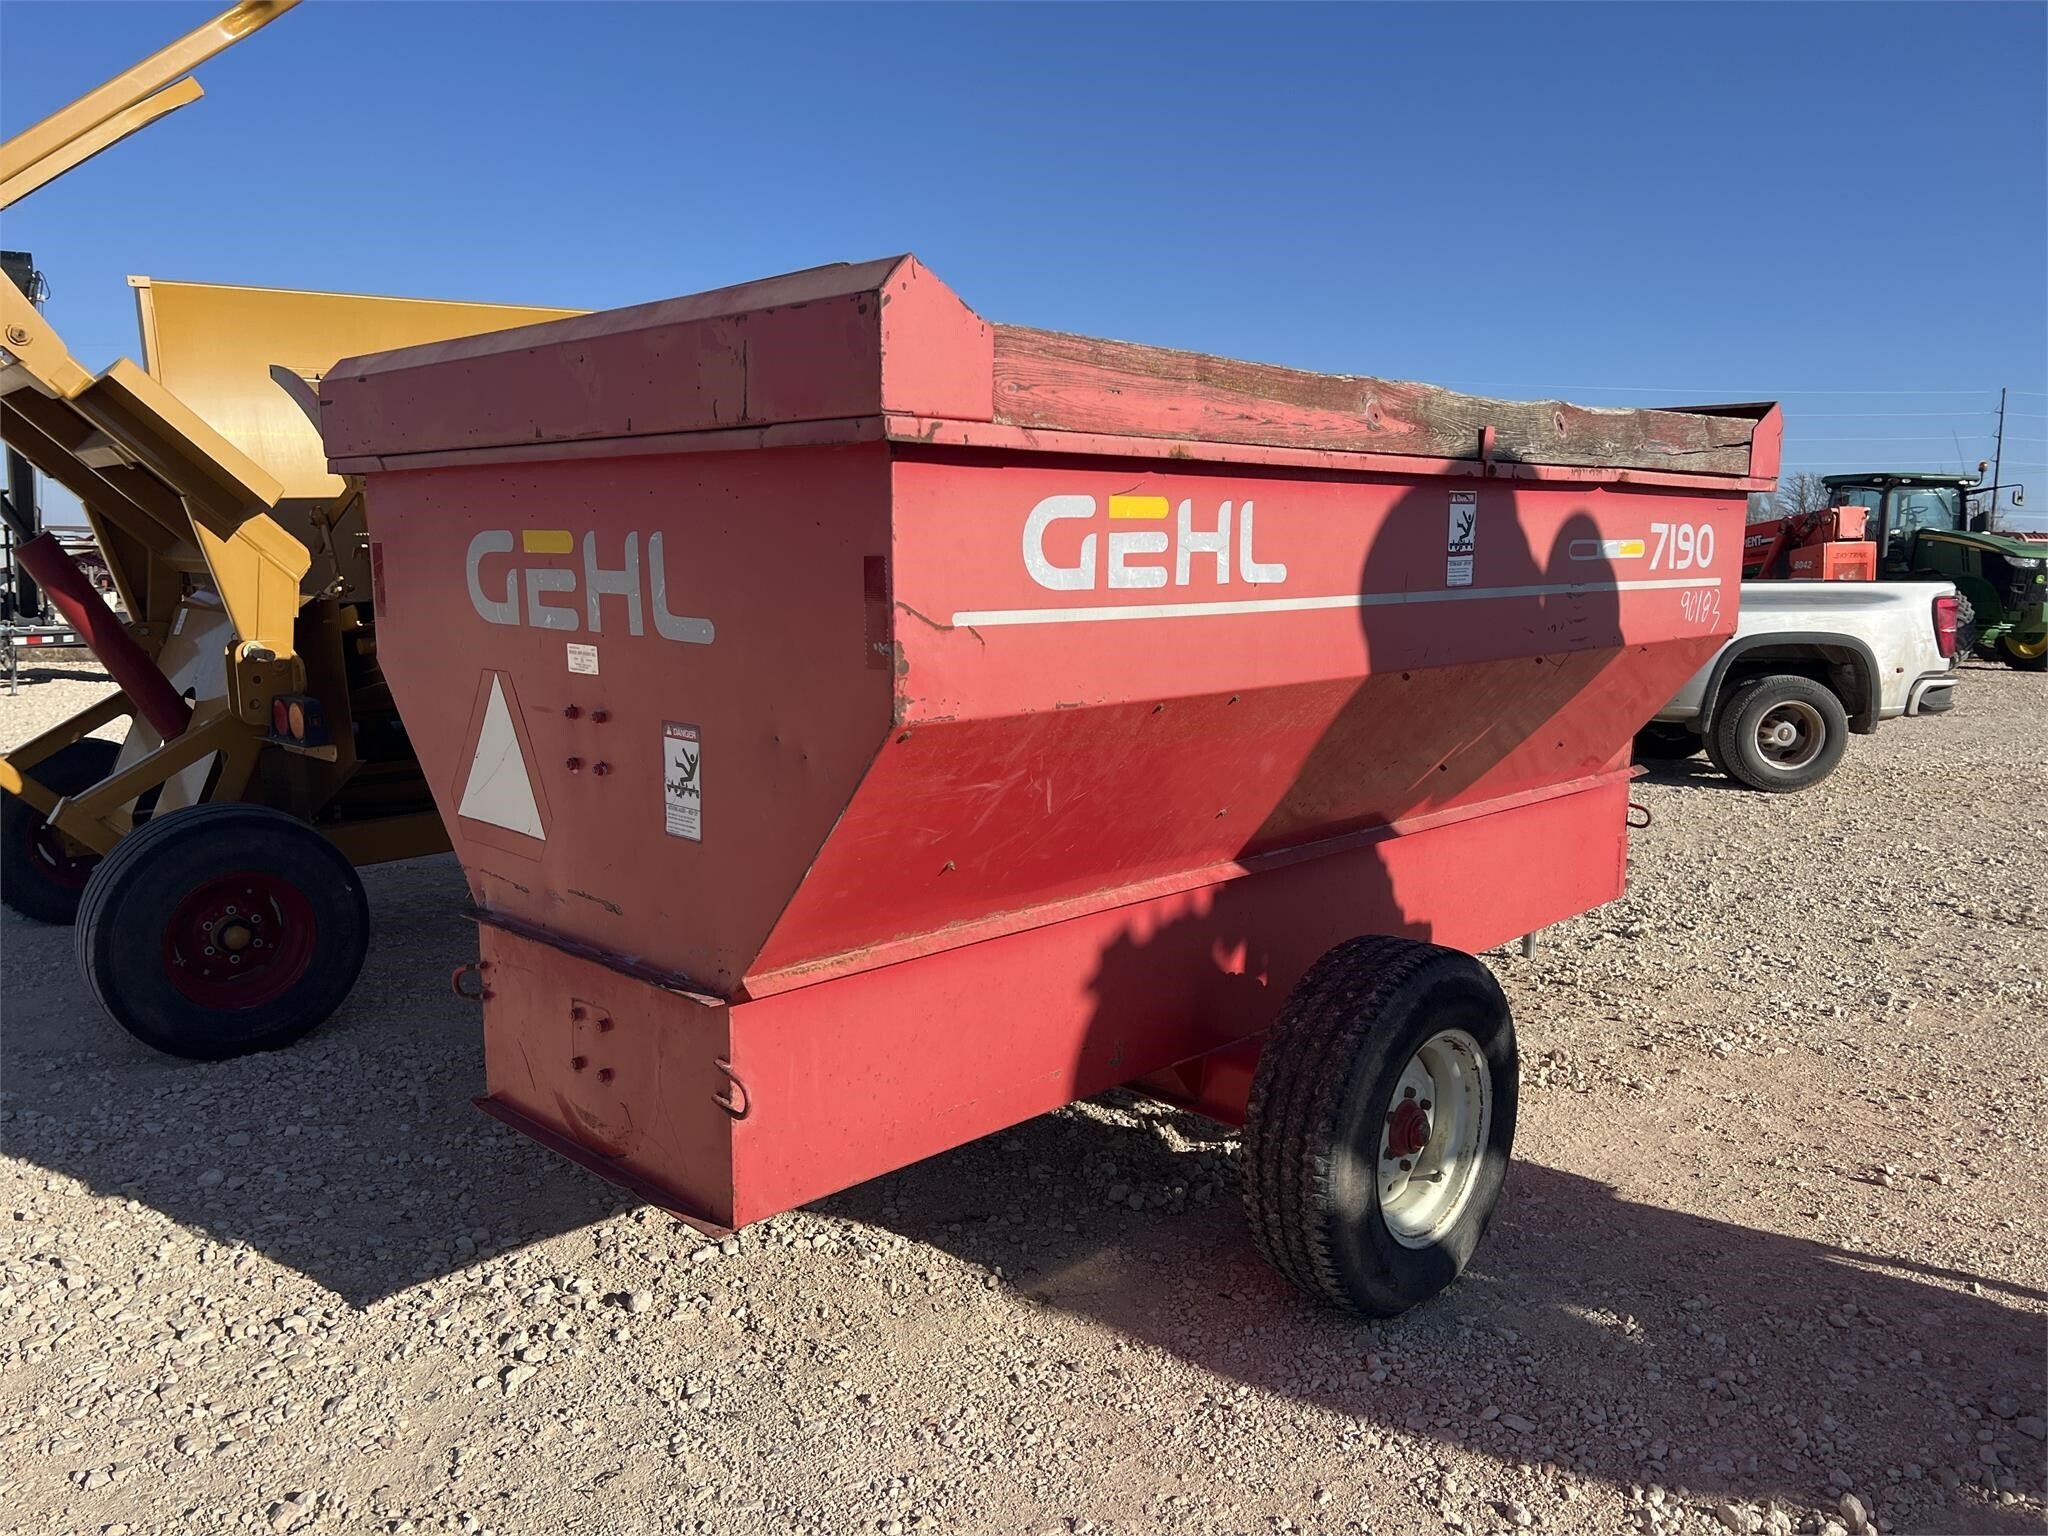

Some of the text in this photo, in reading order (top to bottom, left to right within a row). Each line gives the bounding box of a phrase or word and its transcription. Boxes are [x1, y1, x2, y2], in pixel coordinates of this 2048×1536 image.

[1023, 495, 1287, 591] GEHL
[1649, 523, 1715, 570] 7190
[466, 530, 715, 645] GEHL
[1680, 588, 1721, 634] 90183
[673, 727, 697, 740] DANGER
